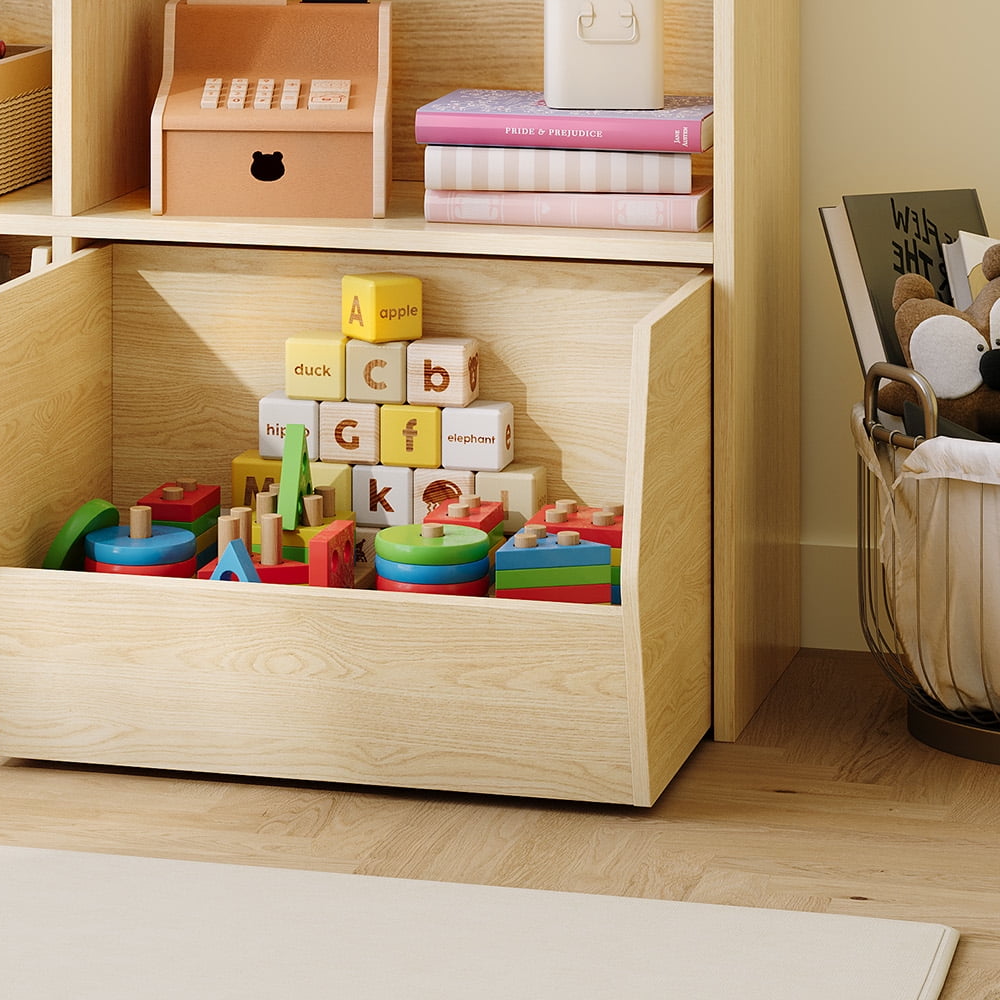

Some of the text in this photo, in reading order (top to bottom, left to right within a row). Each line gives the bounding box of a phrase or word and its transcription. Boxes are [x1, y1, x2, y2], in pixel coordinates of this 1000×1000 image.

[505, 127, 603, 138] PRIDE & PREJUDICE
[348, 295, 364, 327] A
[379, 304, 418, 321] apple
[294, 363, 332, 377] duck
[423, 359, 450, 393] b
[334, 418, 360, 450] G
[402, 418, 418, 453] f
[447, 433, 496, 445] elephant
[505, 424, 511, 451] e
